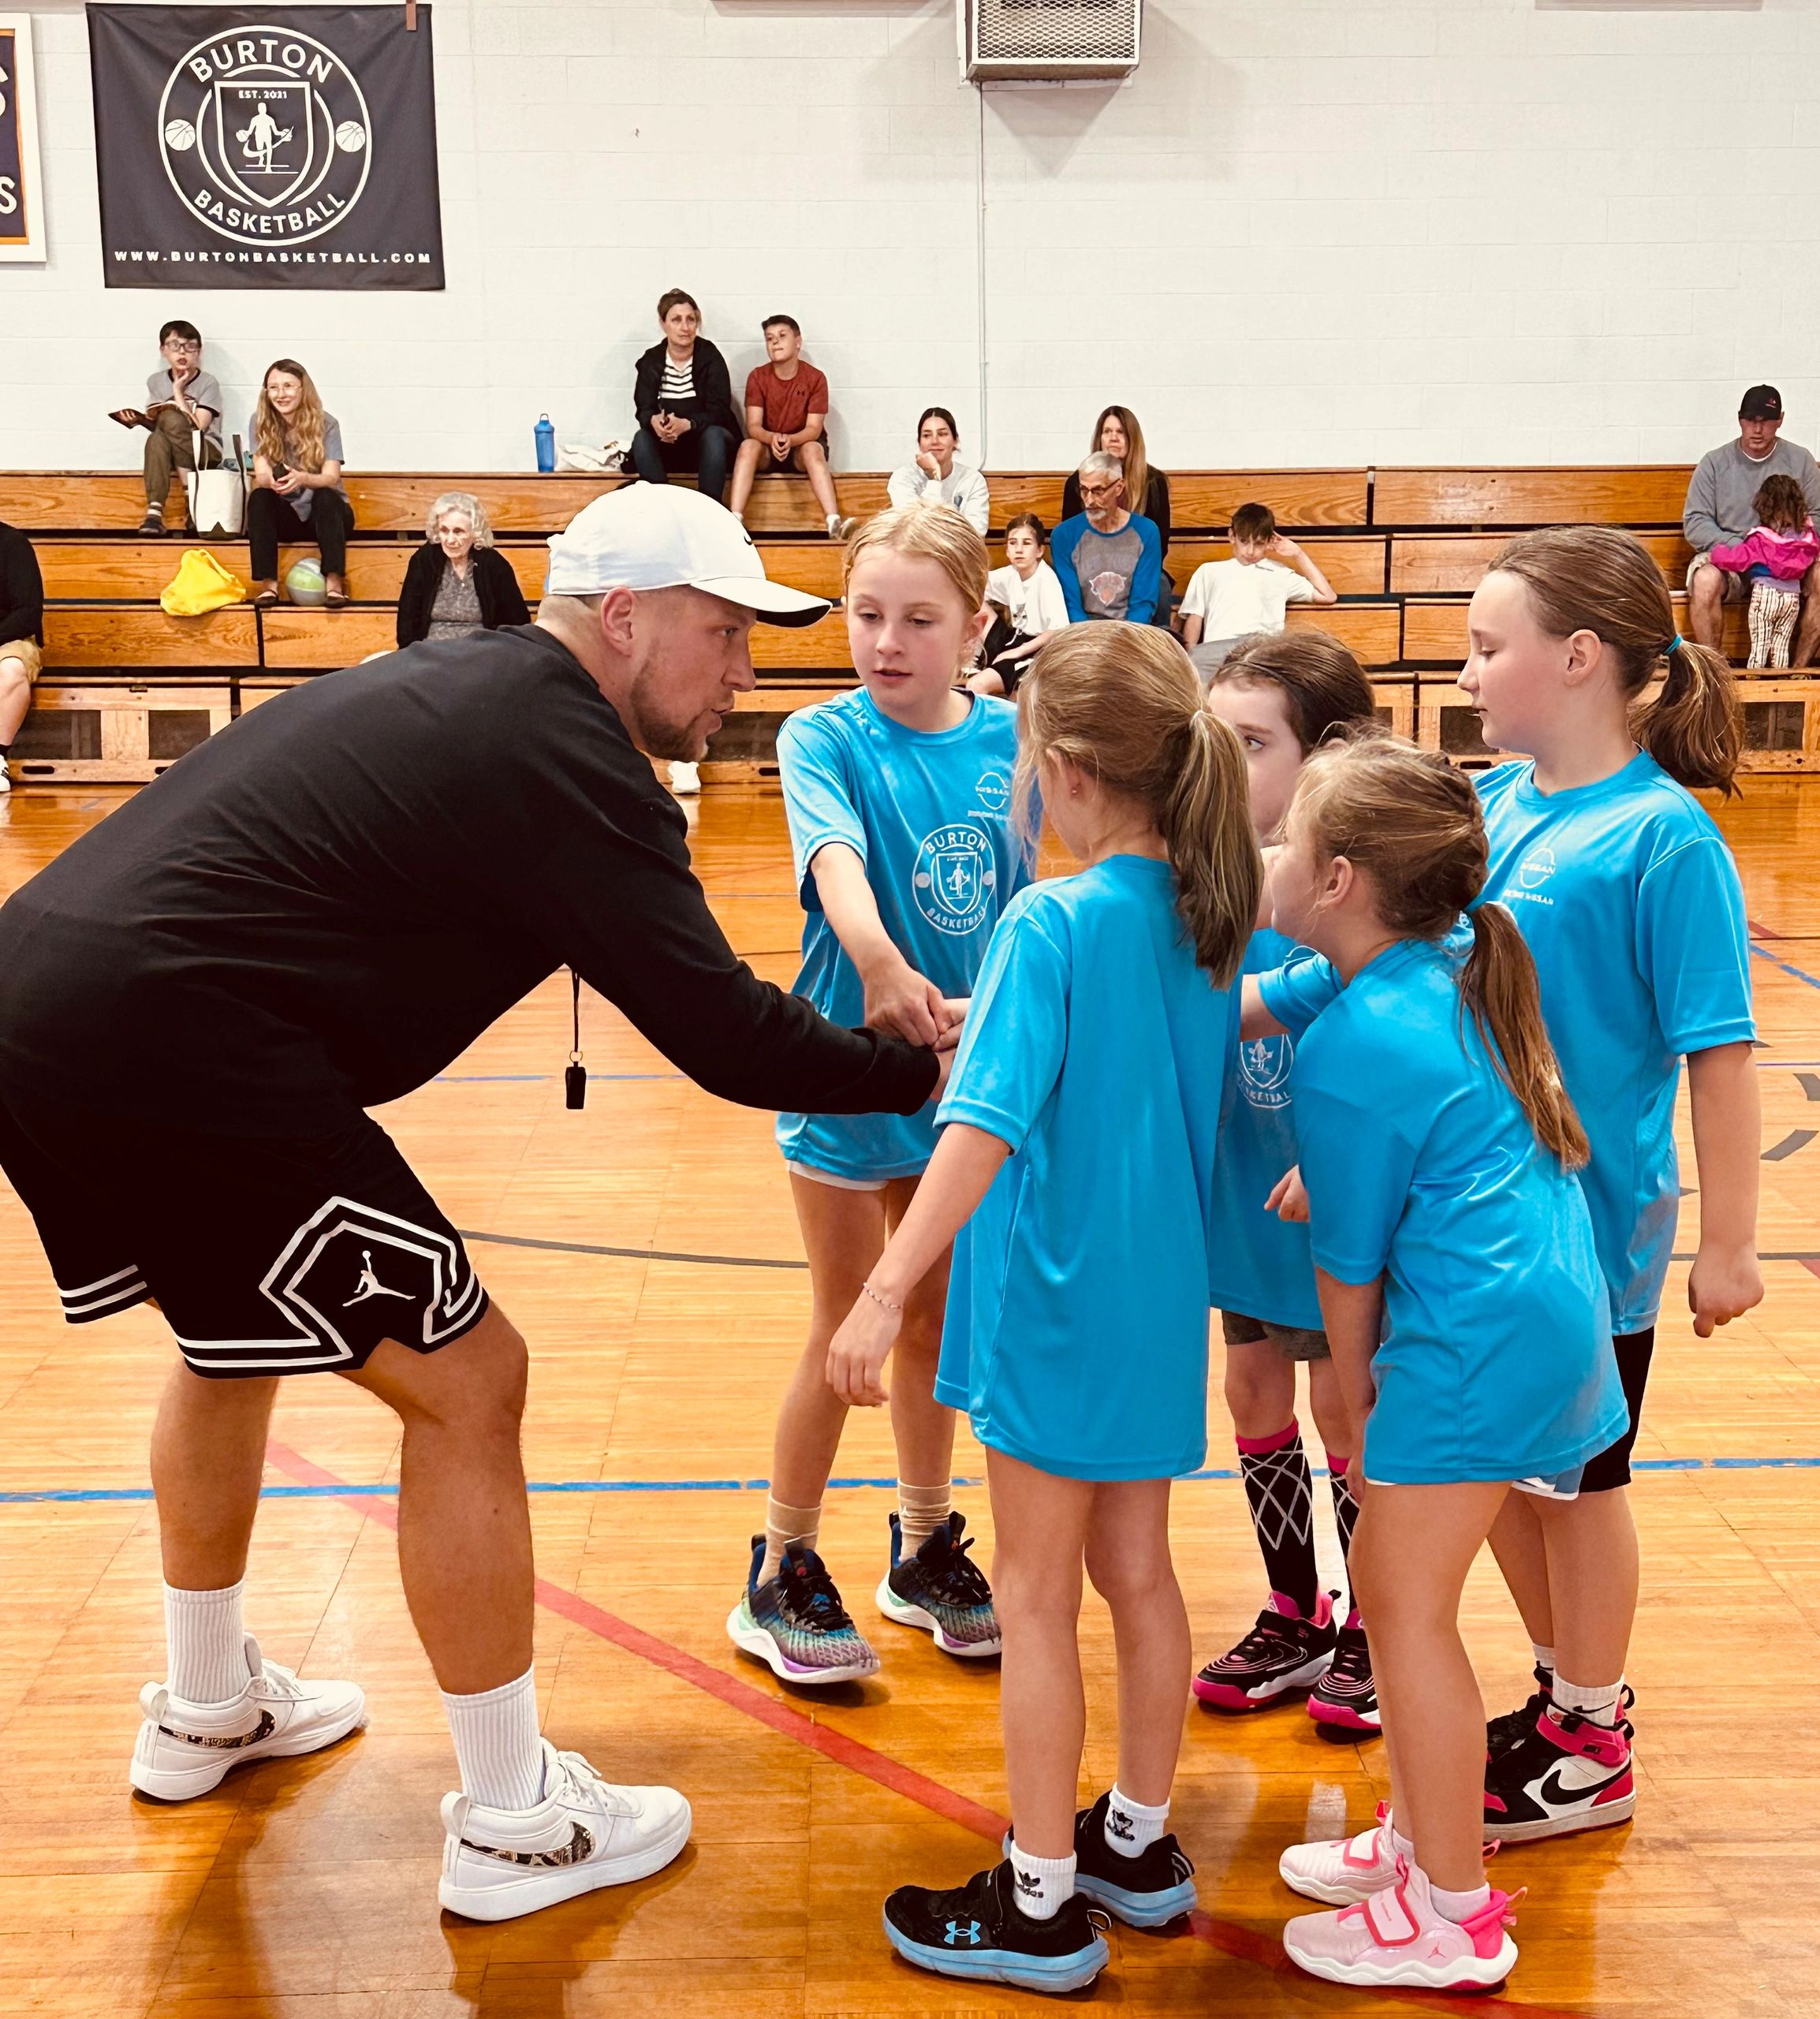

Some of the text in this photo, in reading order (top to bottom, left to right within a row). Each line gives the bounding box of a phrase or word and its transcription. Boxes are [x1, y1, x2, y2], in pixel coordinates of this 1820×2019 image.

[188, 39, 334, 83] BURTON
[238, 90, 287, 99] EST. 2021
[194, 188, 346, 234] BASKETBALL
[114, 251, 431, 263] WWW.BURTONBASKETBALL.COM
[925, 831, 986, 855] BURTON
